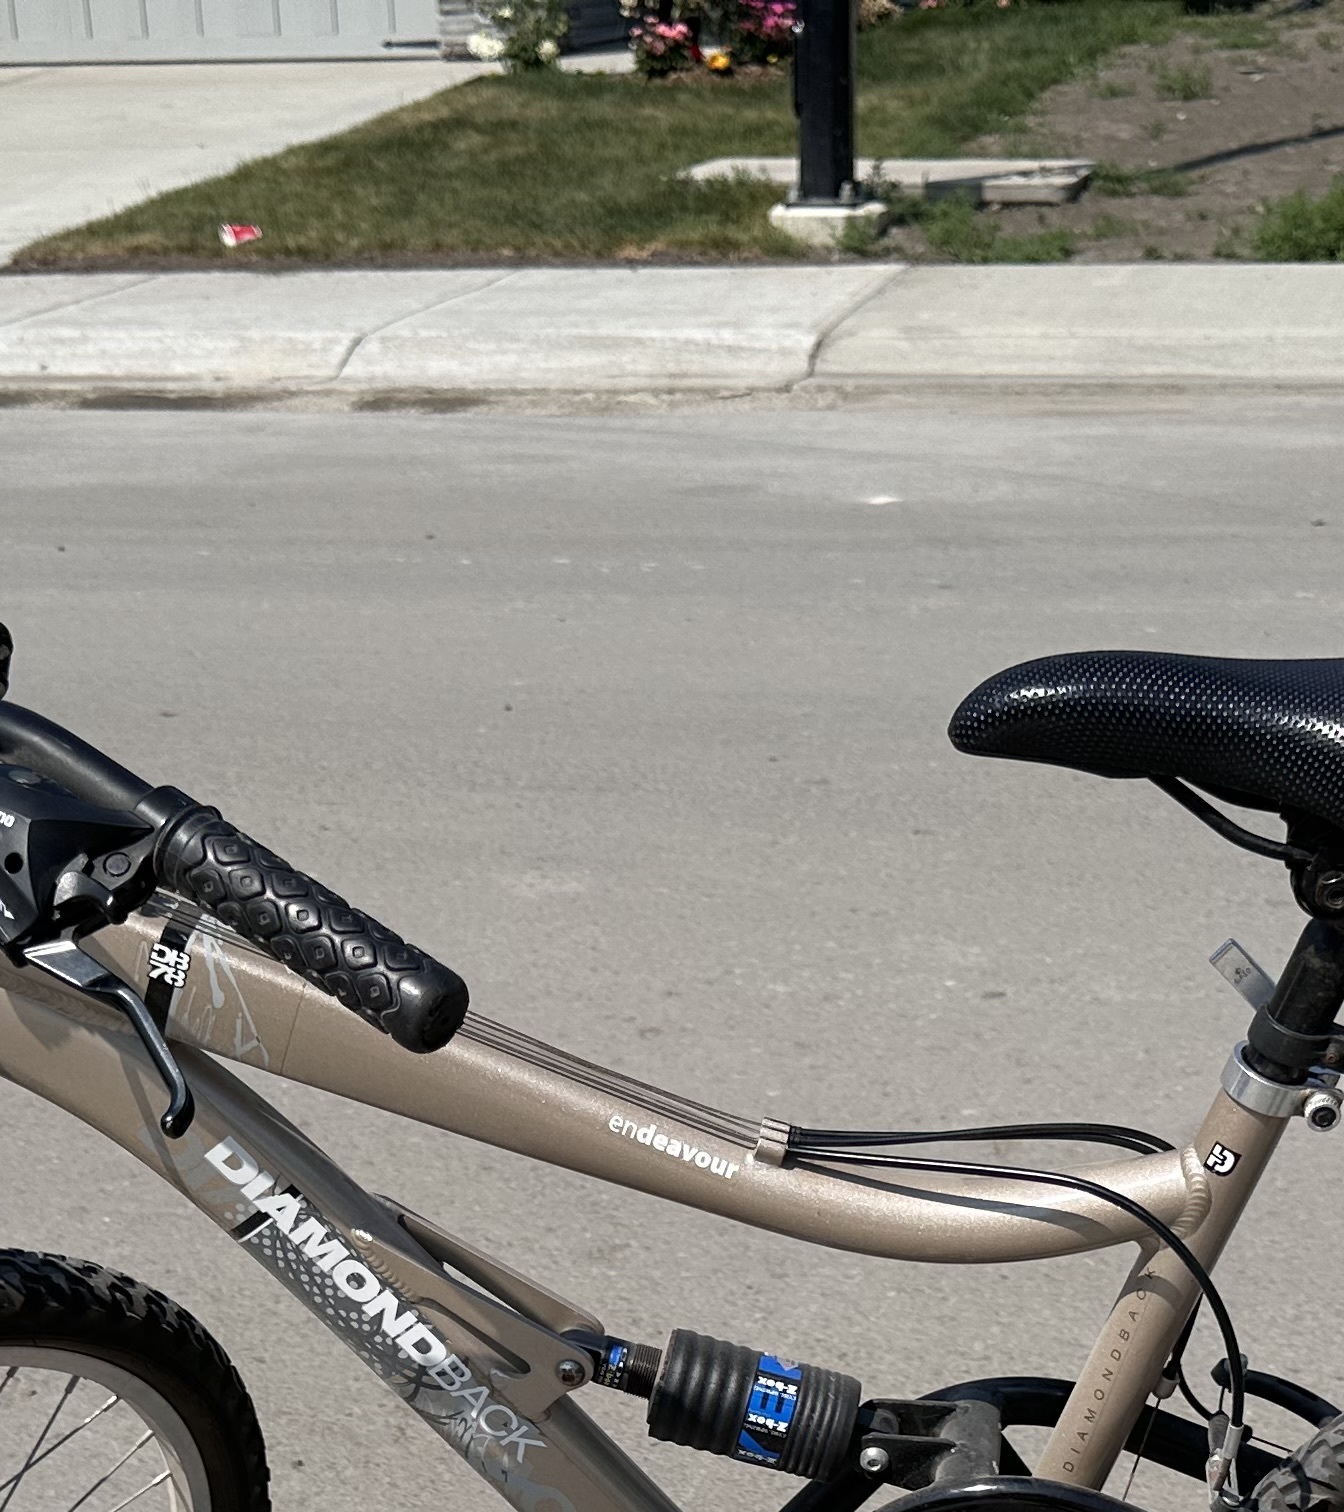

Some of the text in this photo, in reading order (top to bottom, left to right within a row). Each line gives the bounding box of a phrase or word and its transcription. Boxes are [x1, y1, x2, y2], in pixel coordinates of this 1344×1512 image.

[608, 1115, 740, 1179] endeavour
[1062, 1266, 1156, 1473] DIAMONDBACK
[746, 1412, 789, 1433] Z-box
